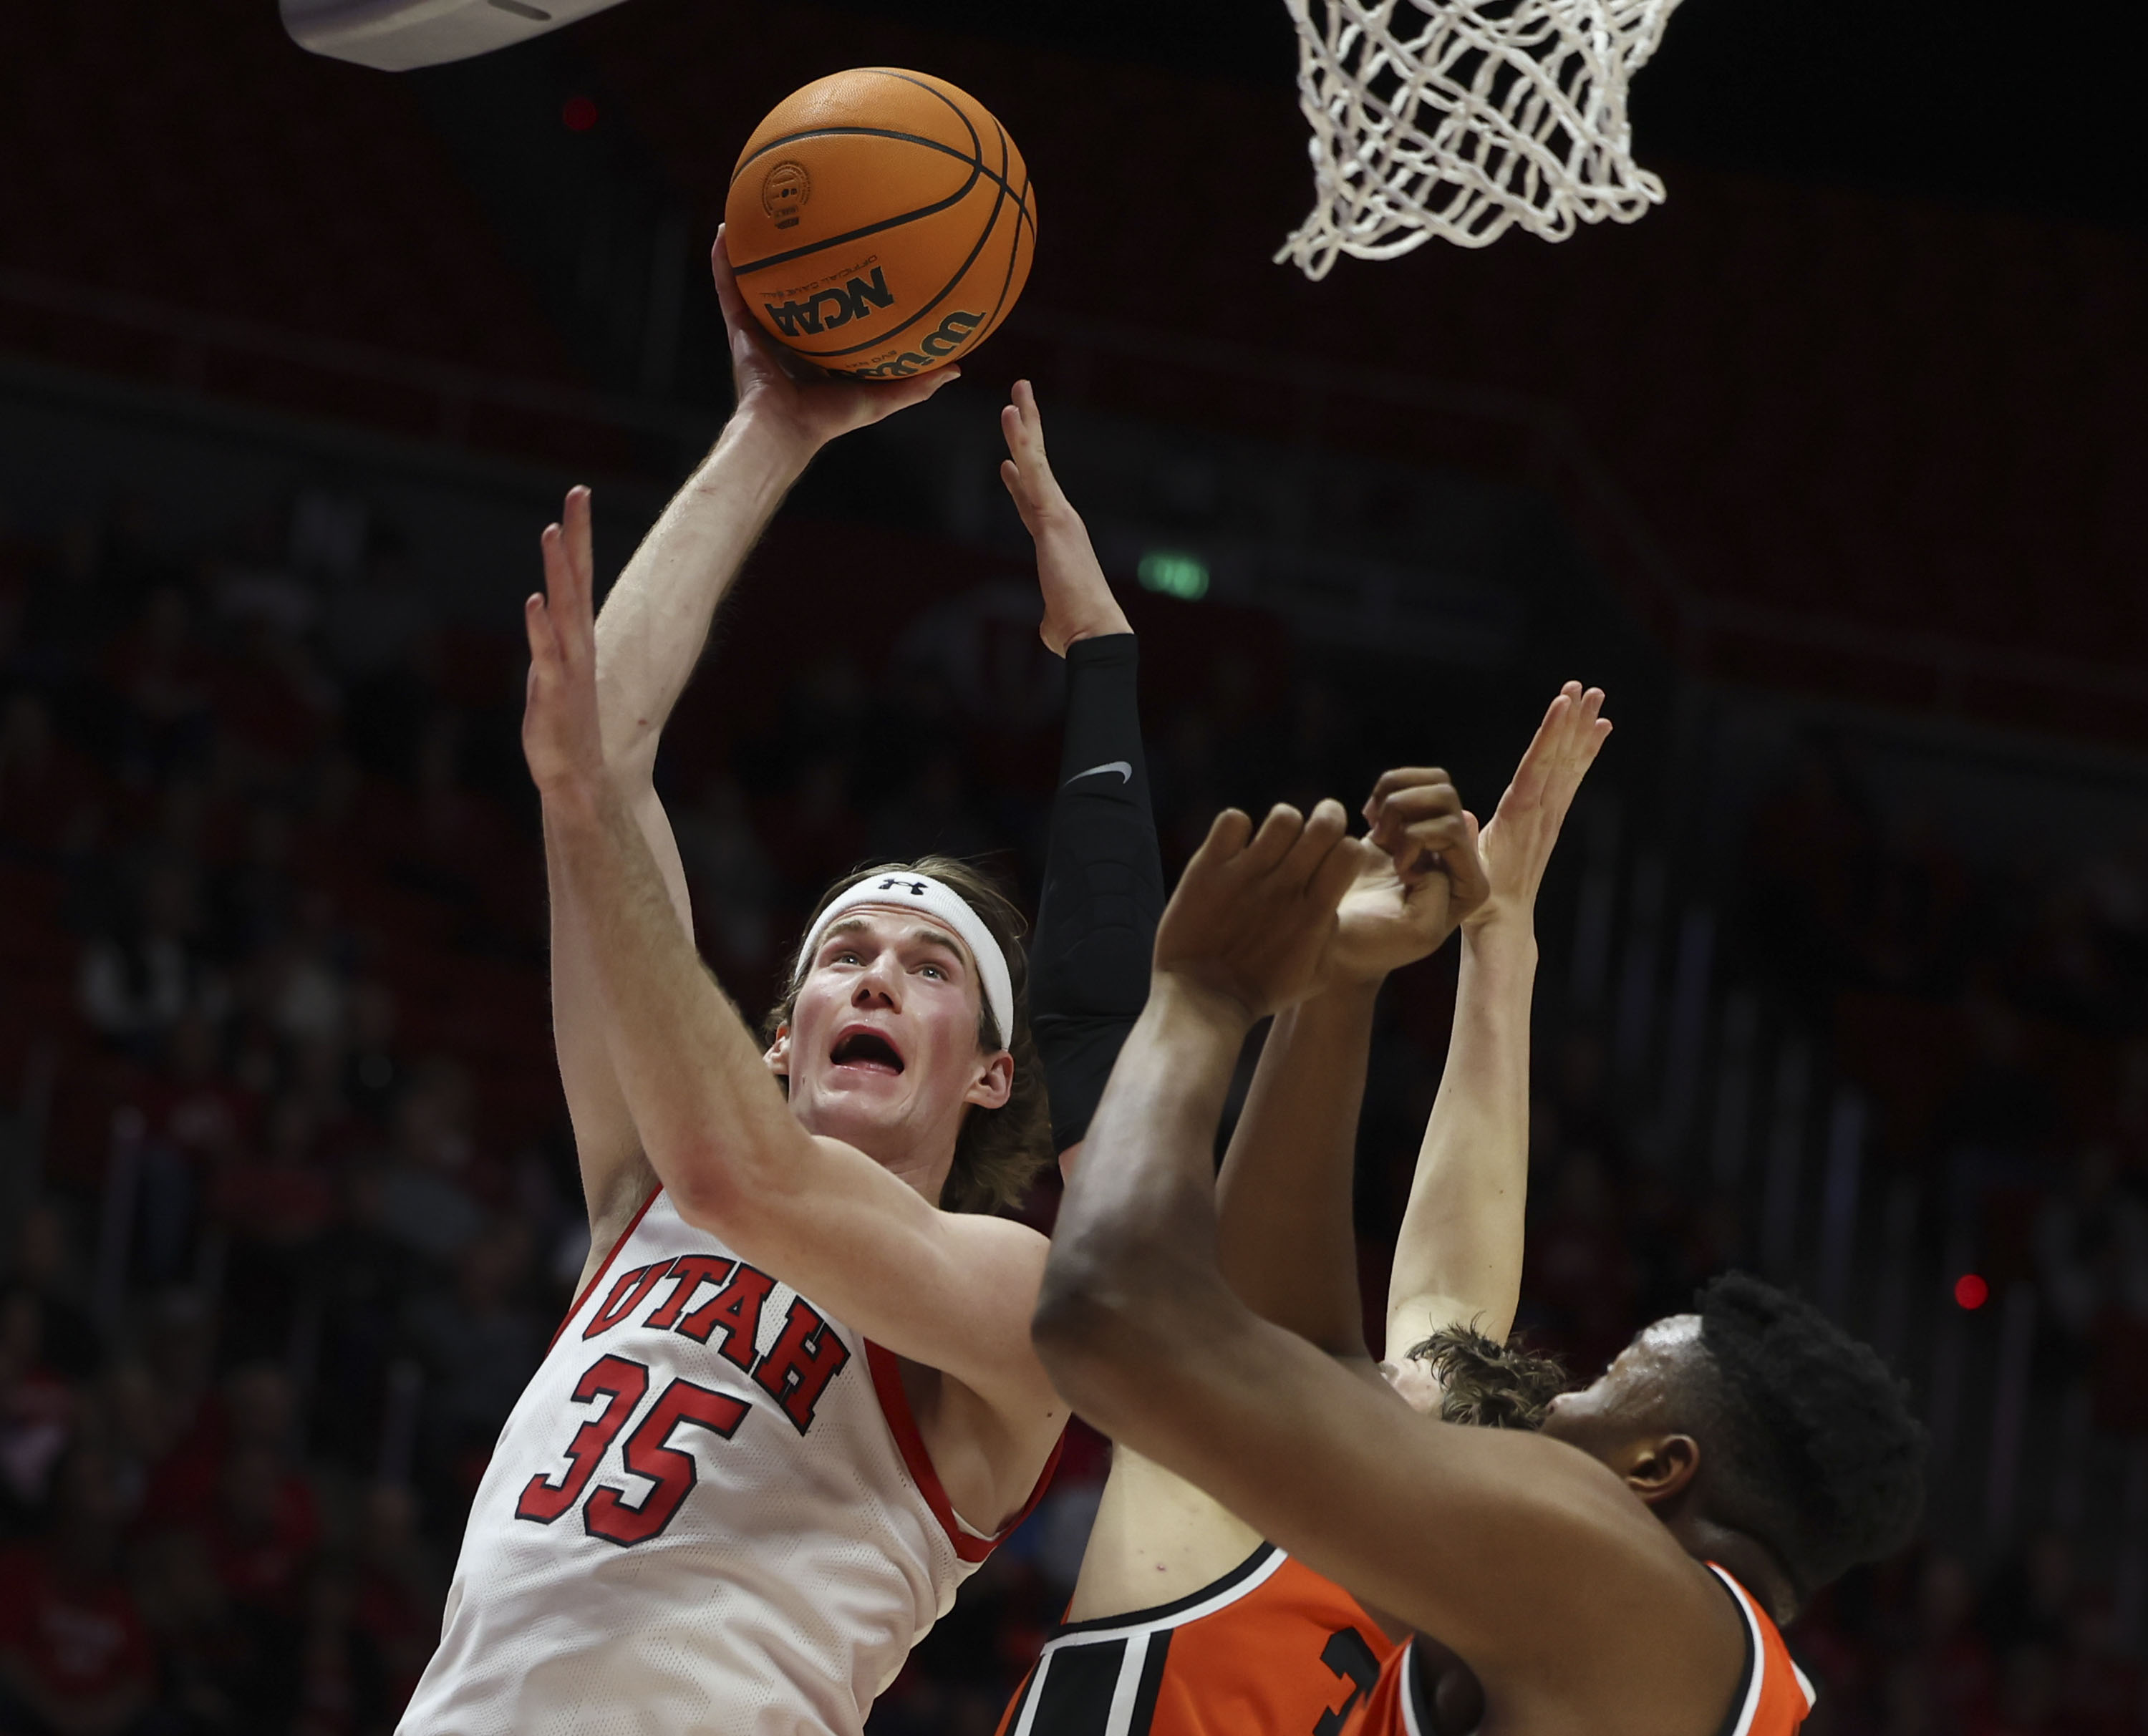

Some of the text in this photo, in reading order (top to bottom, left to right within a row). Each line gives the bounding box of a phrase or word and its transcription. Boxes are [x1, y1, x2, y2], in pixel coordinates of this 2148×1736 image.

[764, 266, 894, 336] NCAA
[786, 281, 820, 296] GAME
[821, 254, 879, 283] OFFICIAL
[827, 310, 987, 379] Wils
[581, 1253, 851, 1437] UTAH
[514, 1353, 753, 1548] 35
